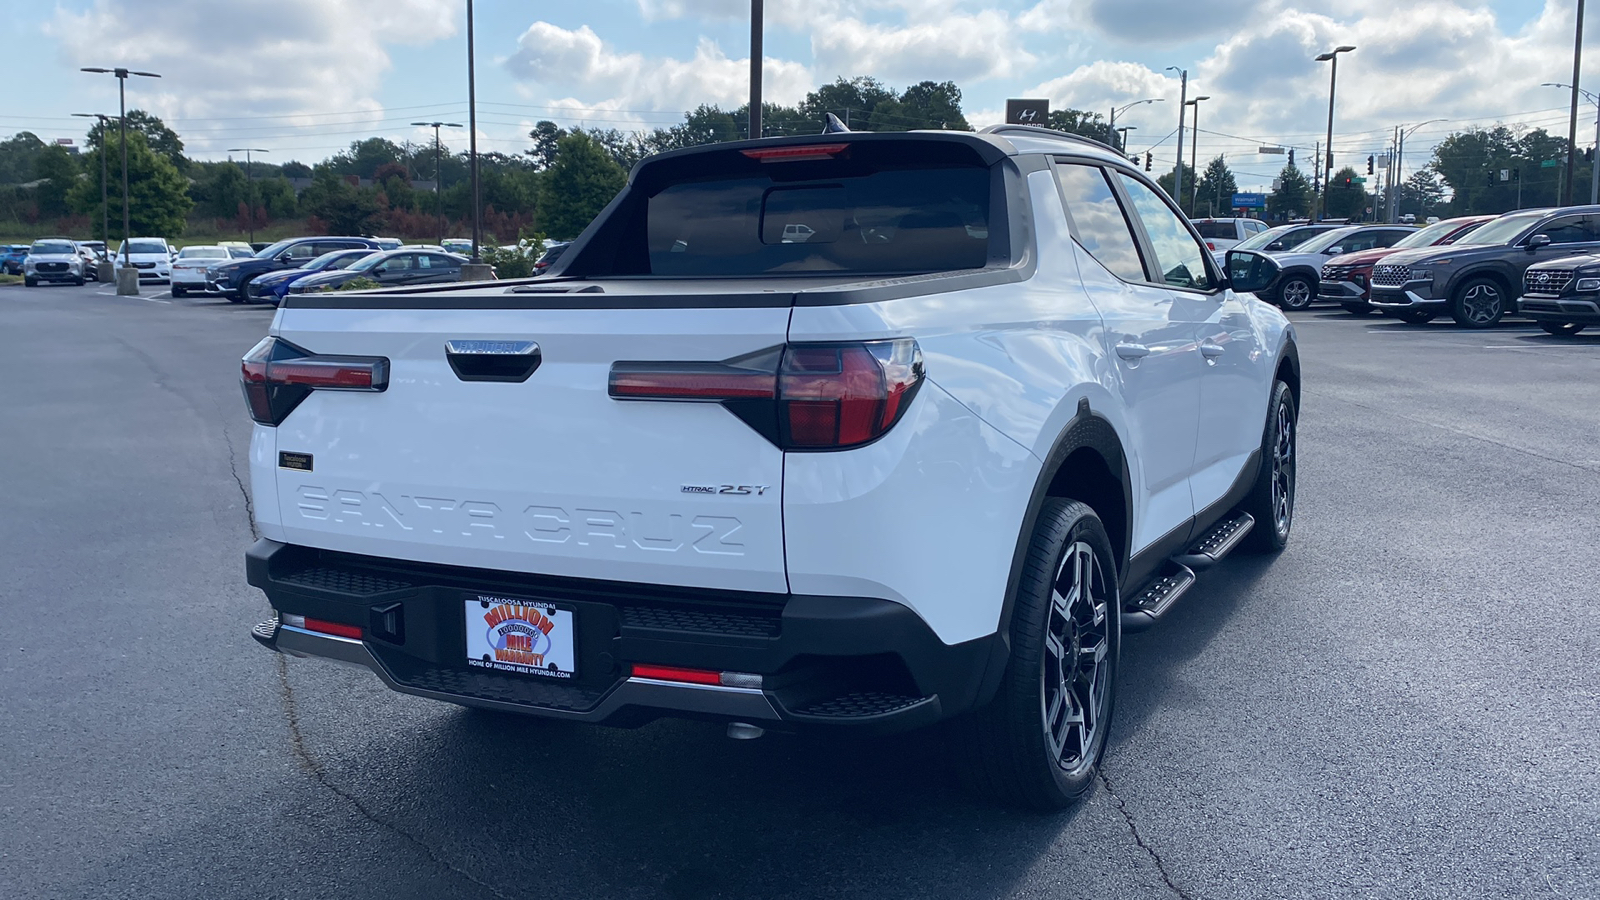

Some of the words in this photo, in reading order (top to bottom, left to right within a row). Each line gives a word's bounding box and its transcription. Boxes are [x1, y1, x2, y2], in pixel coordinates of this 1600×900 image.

[458, 341, 519, 354] HYUNDAI
[682, 485, 714, 493] HTRAC
[296, 484, 505, 539] SANTA
[522, 504, 746, 557] CRUZ
[477, 595, 522, 606] TUSCALOOSA
[522, 601, 556, 610] HYUNDAI
[483, 604, 555, 636] MILLION
[506, 634, 533, 653] MILE
[495, 648, 545, 667] WARRANTY
[468, 659, 485, 668] HOME
[485, 661, 493, 669] OF
[493, 663, 516, 673] MILLION
[516, 666, 529, 674] MILE
[529, 668, 571, 679] HYUNDAI.COM
